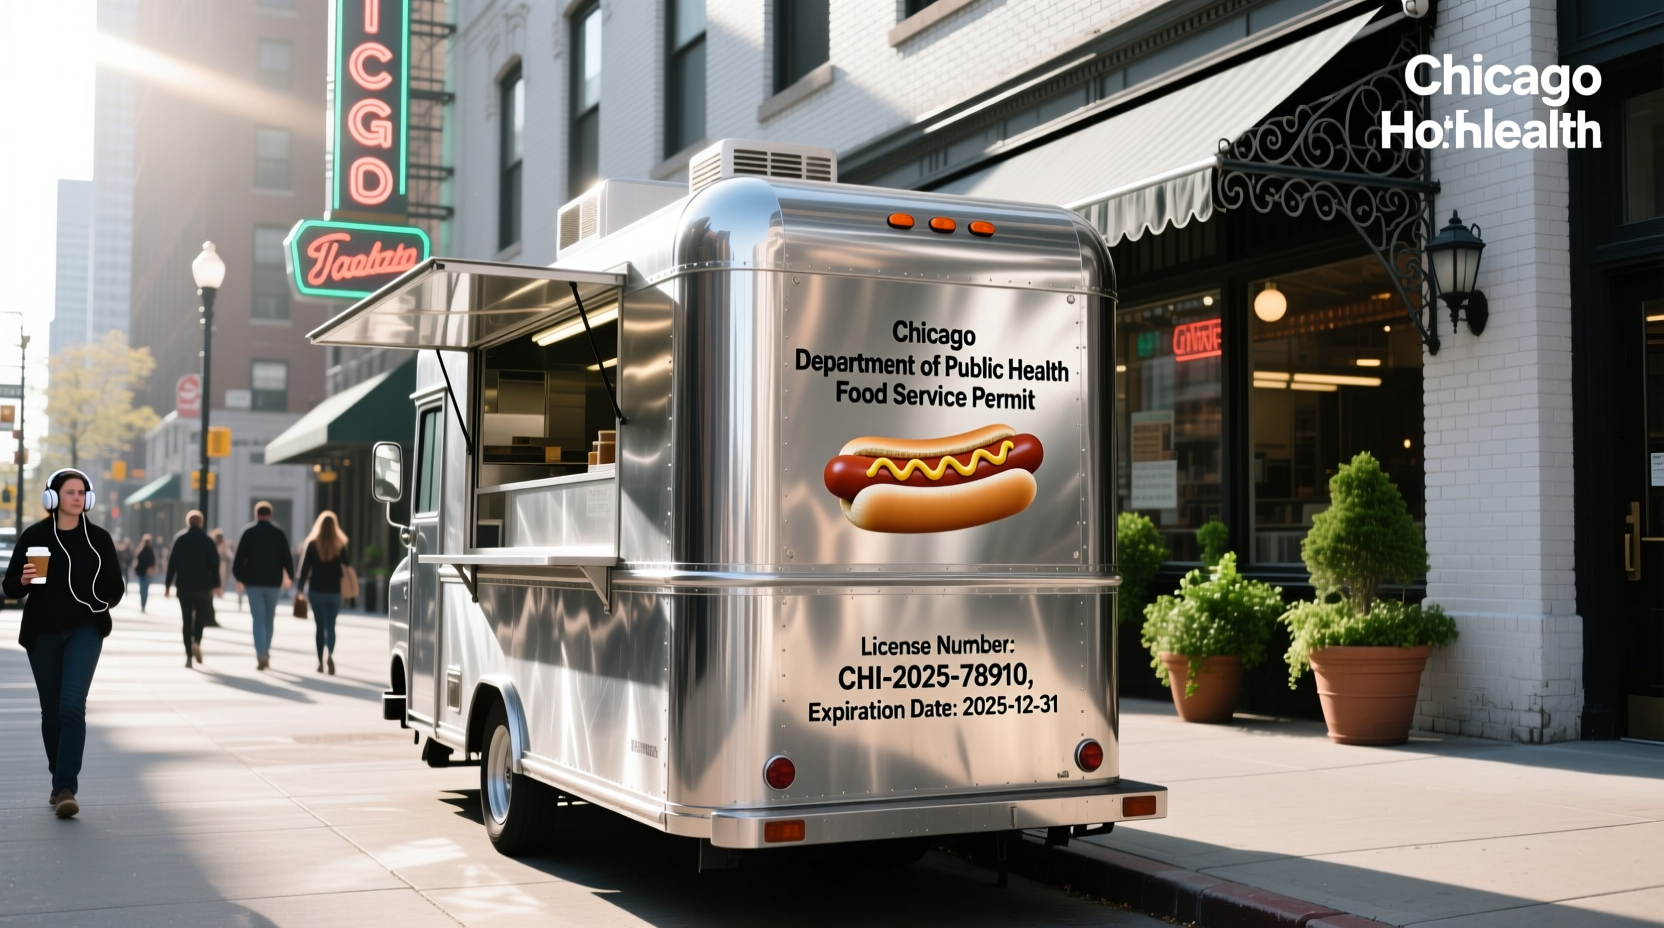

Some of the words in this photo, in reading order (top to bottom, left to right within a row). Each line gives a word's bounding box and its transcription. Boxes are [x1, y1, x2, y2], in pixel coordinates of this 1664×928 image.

[893, 320, 976, 351] Chicago
[795, 348, 915, 377] Department
[920, 354, 941, 376] of
[945, 355, 1004, 379] Public
[1008, 358, 1069, 382] Health
[836, 380, 887, 404] Food
[893, 383, 967, 407] Service
[972, 386, 1036, 410] Permit
[861, 636, 931, 656] License
[937, 634, 1015, 654] Number:
[838, 662, 1034, 690] CHI-2025-78910,
[808, 699, 905, 726] Expiration
[910, 698, 958, 718] Date:
[962, 694, 1058, 716] 2025-12-31
